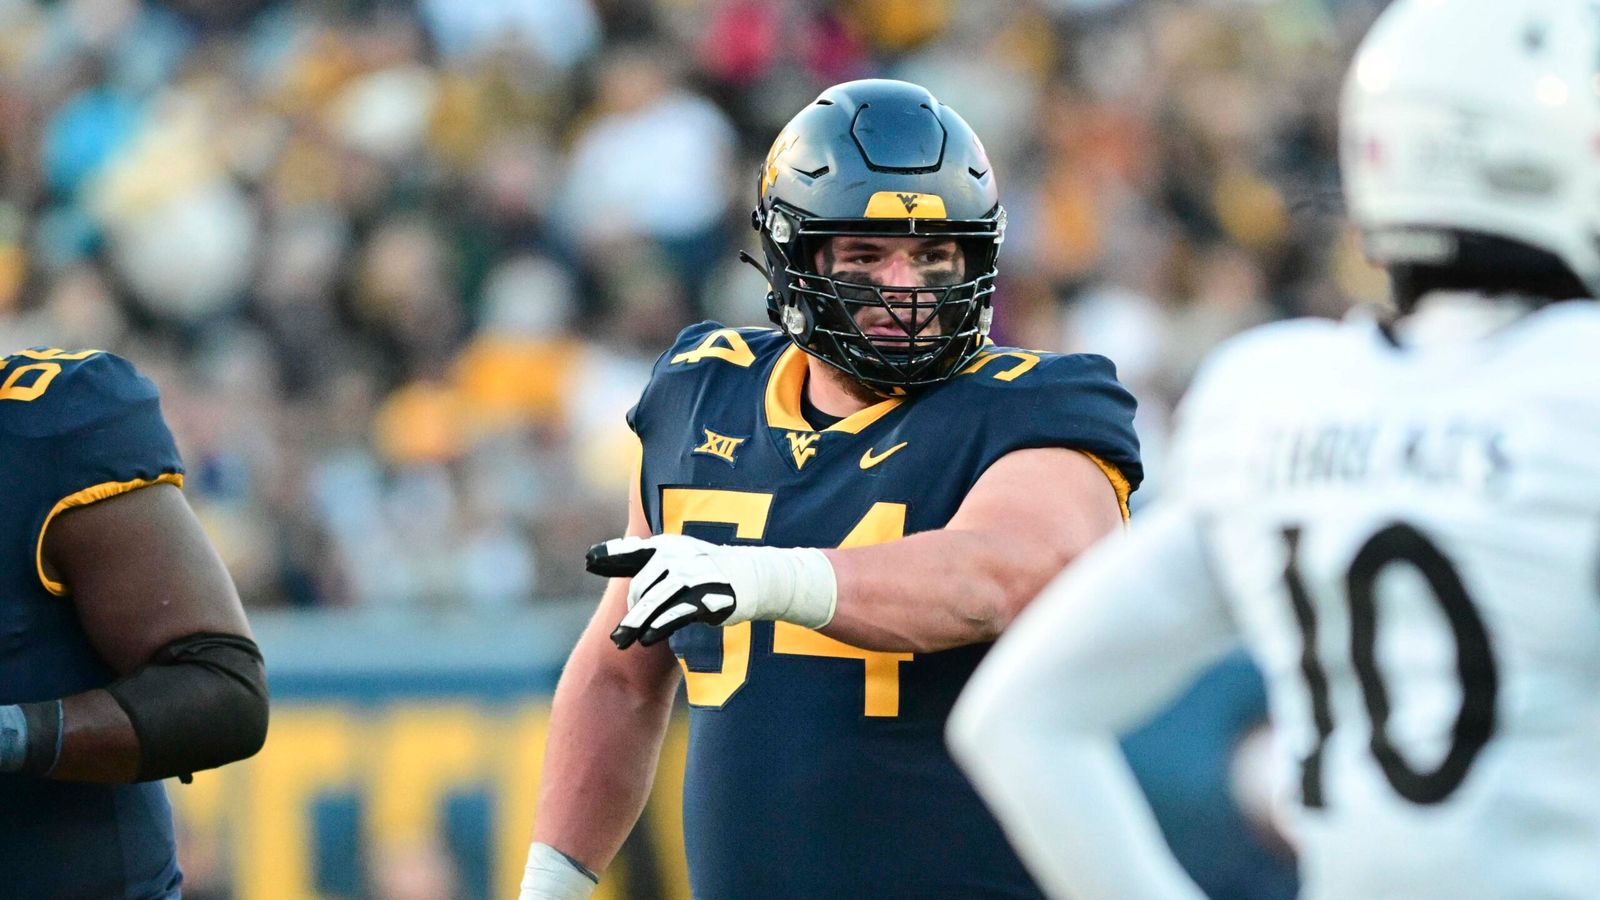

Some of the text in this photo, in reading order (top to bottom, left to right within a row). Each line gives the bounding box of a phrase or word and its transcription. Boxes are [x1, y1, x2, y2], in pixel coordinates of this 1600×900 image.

[670, 329, 756, 367] 4
[962, 350, 1041, 381] 5
[694, 428, 745, 463] XII
[1281, 521, 1499, 807] 10
